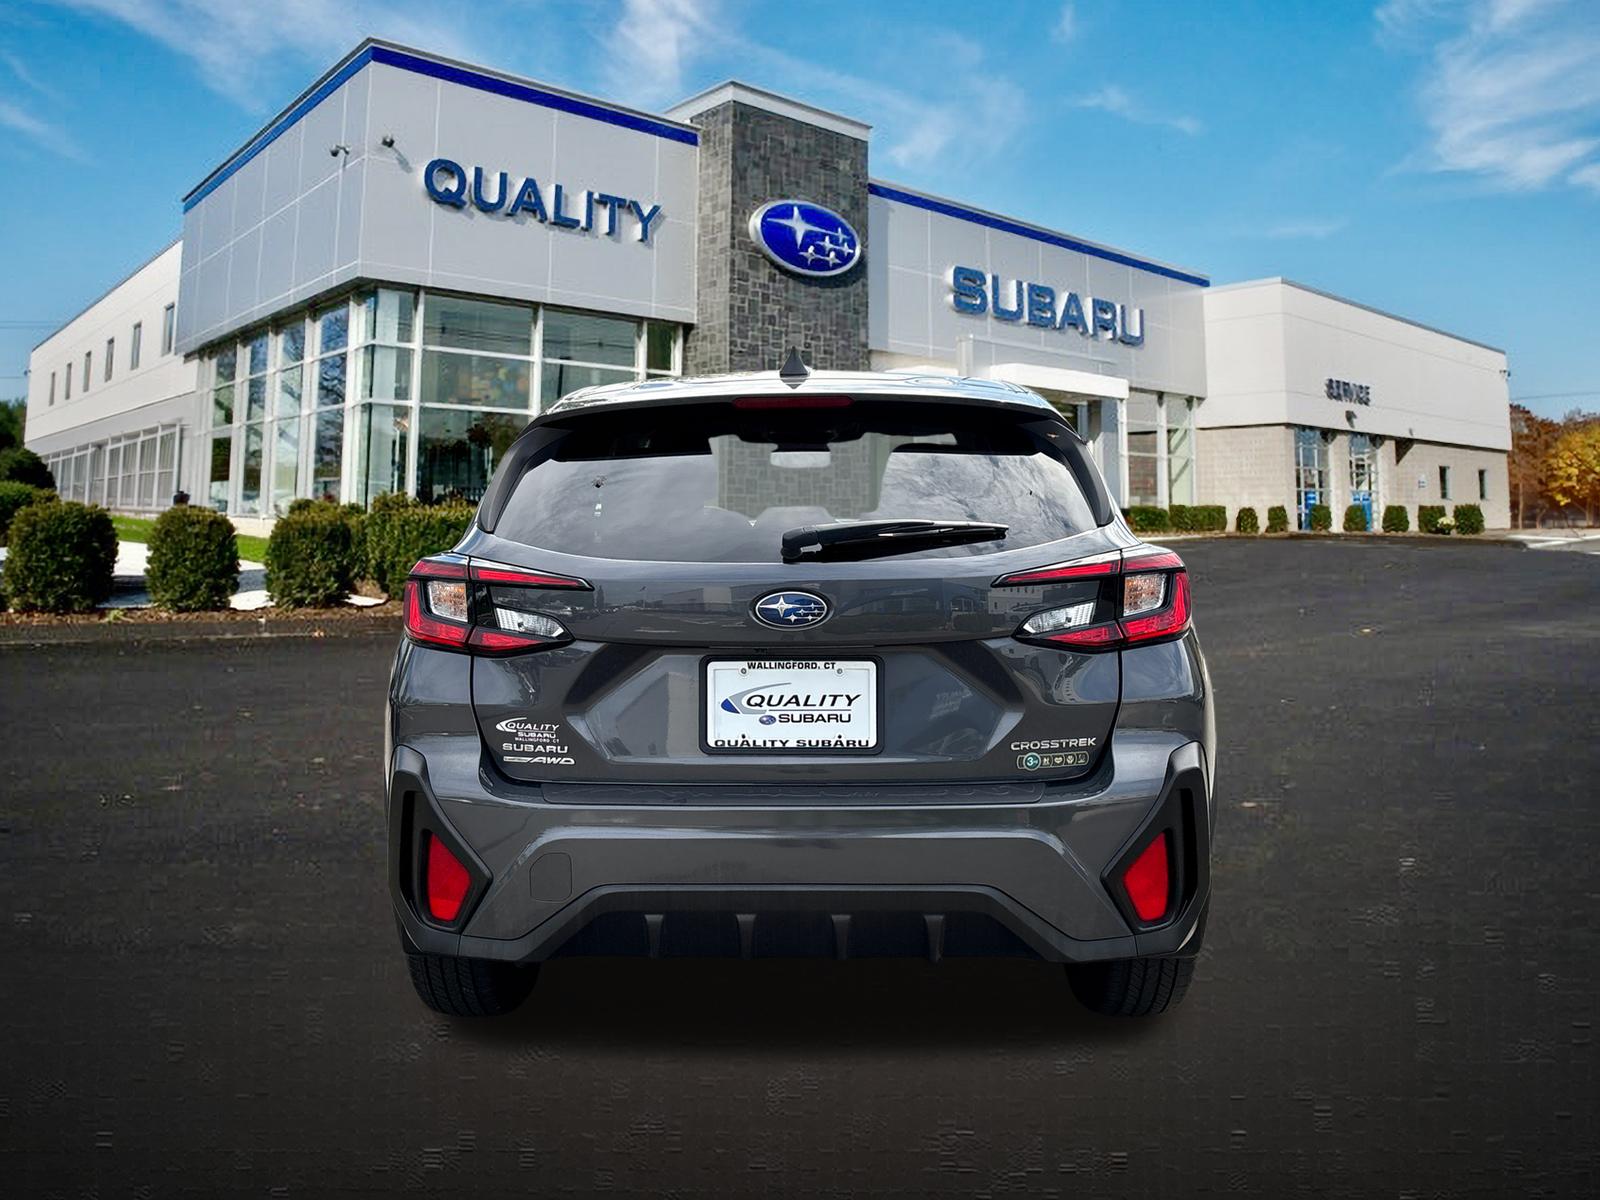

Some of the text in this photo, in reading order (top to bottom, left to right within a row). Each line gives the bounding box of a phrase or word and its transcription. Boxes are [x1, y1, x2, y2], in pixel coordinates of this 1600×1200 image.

[424, 158, 662, 242] QUALITY
[952, 266, 1145, 346] SUBARU
[824, 662, 836, 670] CT
[746, 694, 862, 707] QUALITY
[778, 714, 851, 723] SUBARU
[507, 722, 559, 731] QUALITY
[714, 739, 869, 747] QUALITY SUBARU
[1010, 737, 1097, 751] CROSSTREK
[502, 743, 568, 753] SUBARU
[530, 756, 575, 765] AWD
